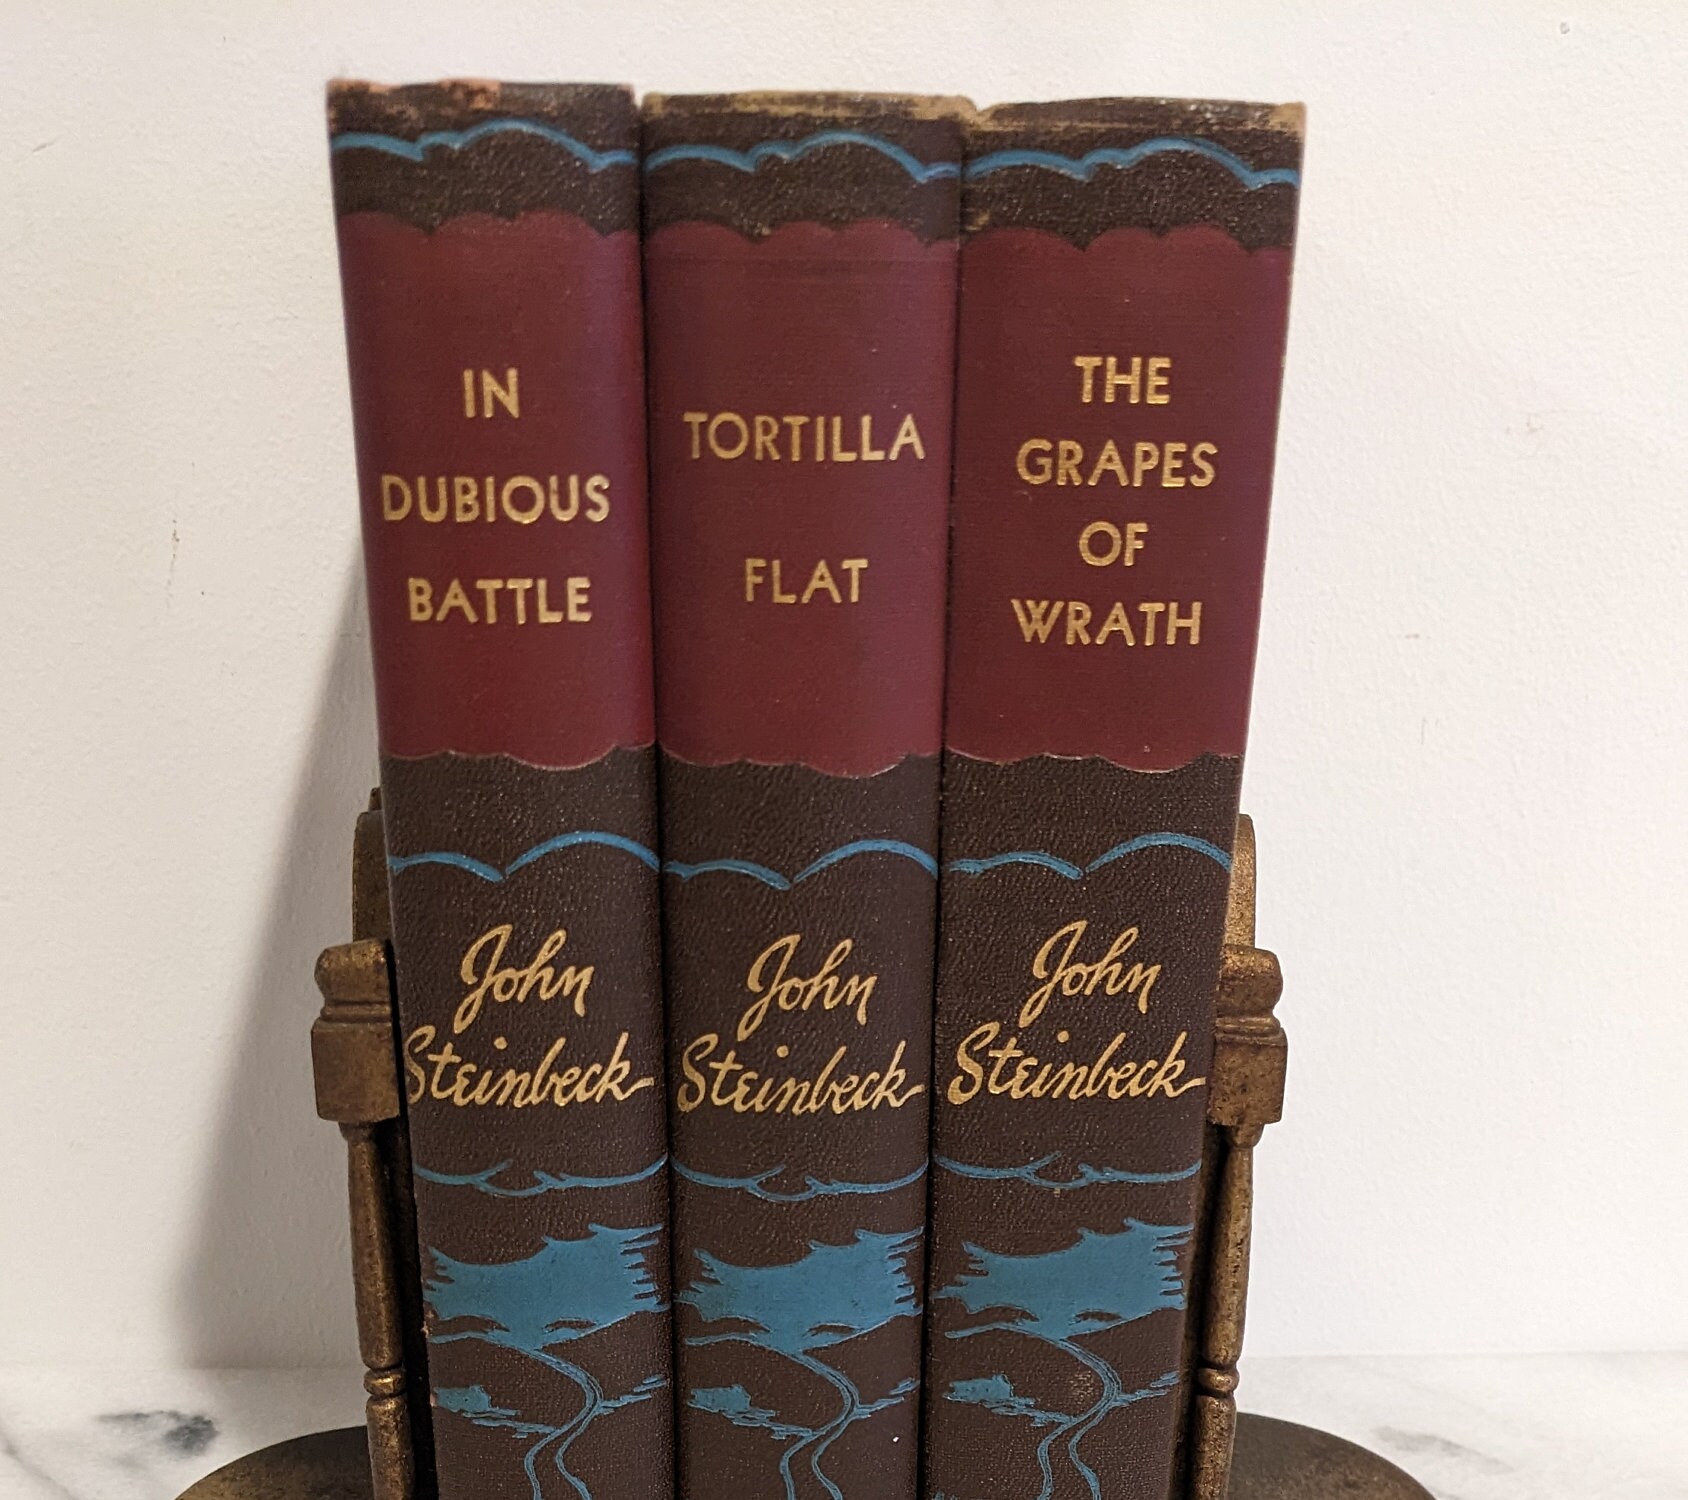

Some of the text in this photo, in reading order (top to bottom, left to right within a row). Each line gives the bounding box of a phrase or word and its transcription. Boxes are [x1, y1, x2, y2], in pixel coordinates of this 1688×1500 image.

[464, 368, 519, 418] IN
[1074, 356, 1171, 404] THE
[685, 413, 924, 461] TORTILLA
[1017, 439, 1218, 487] GRAPES
[383, 475, 609, 524] DUBIOUS
[1079, 522, 1148, 566] OF
[409, 577, 591, 624] BATTLE
[746, 559, 868, 603] FLAT
[1011, 599, 1201, 646] WRATH
[455, 925, 594, 1033] John
[738, 935, 877, 1041] John
[1019, 920, 1161, 1028] John
[406, 1026, 654, 1107] Steinbeck
[681, 1033, 924, 1115] Steinbeck
[948, 1021, 1205, 1104] Steinbeck
